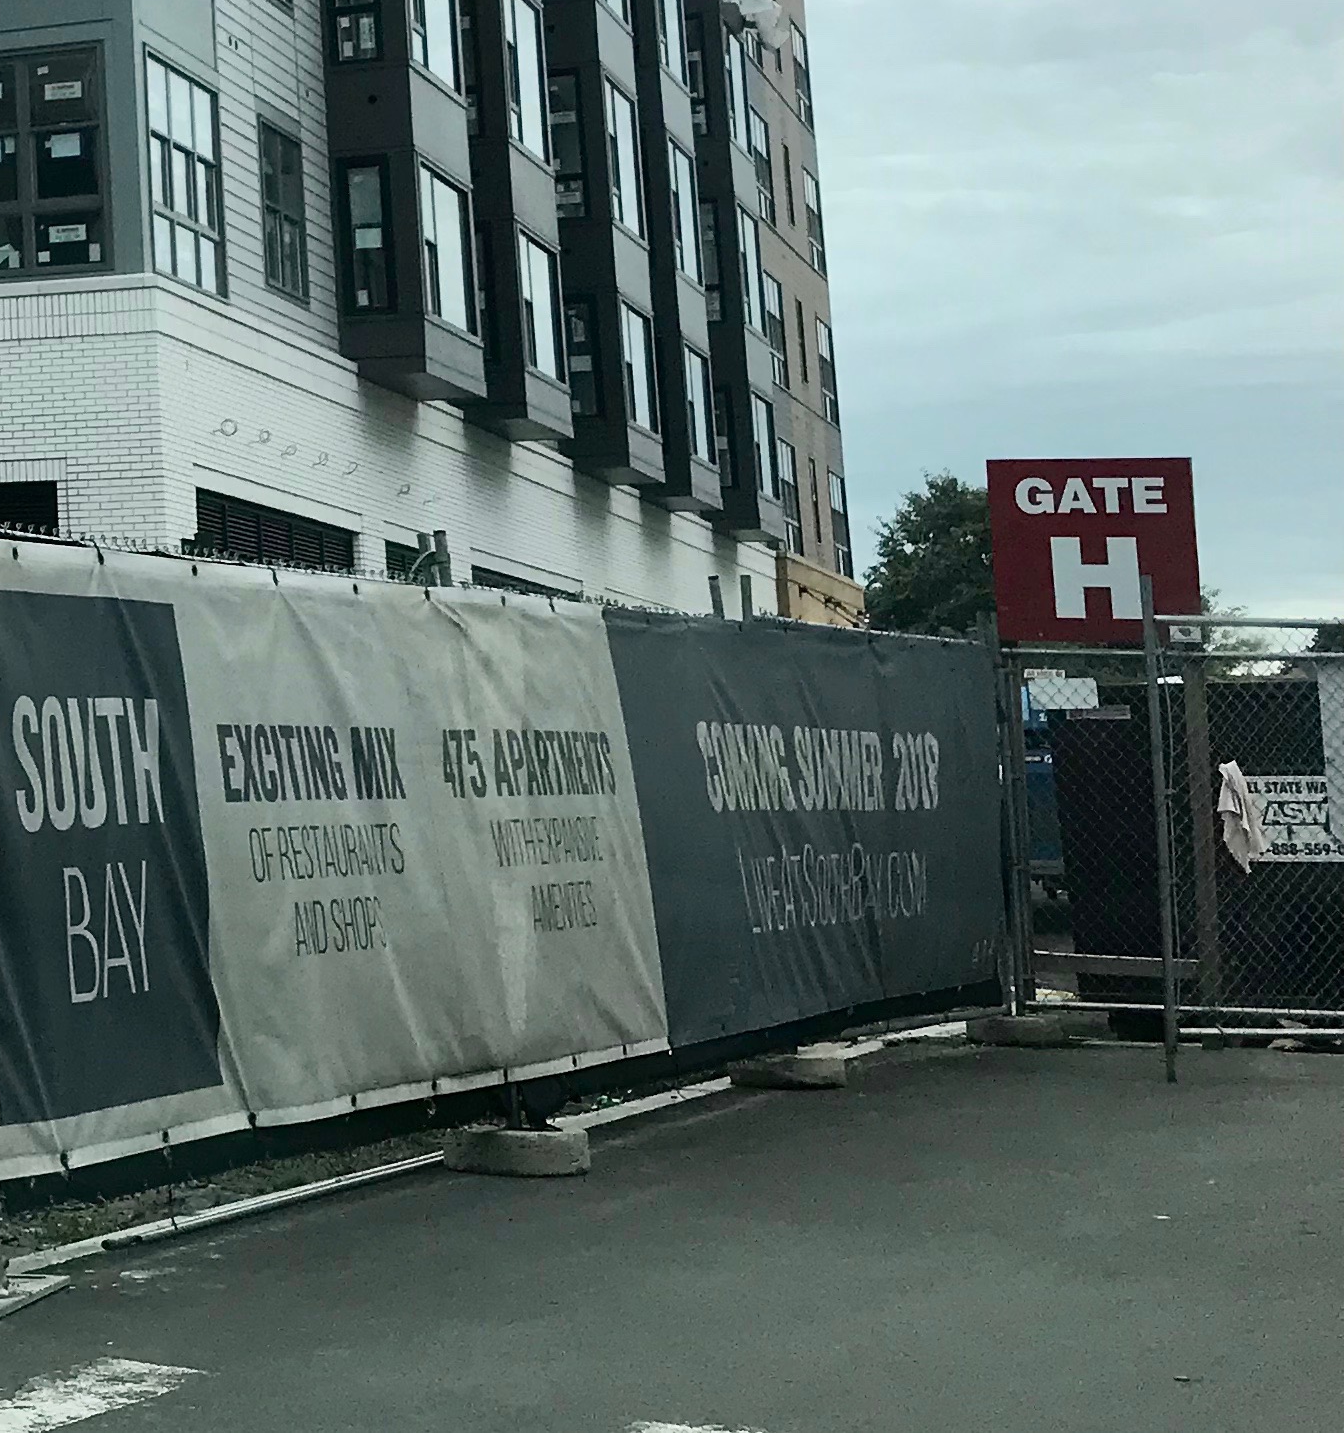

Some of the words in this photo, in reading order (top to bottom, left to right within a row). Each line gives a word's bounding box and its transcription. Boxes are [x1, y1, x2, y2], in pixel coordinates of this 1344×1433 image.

[1014, 477, 1168, 514] GATE
[1050, 536, 1143, 619] H
[12, 695, 164, 833] SOUTH
[217, 723, 348, 802] EXCITING
[350, 726, 407, 800] MIX
[442, 728, 487, 798] 475
[492, 728, 616, 796] APARTMENTS
[696, 721, 798, 813] COMING
[793, 725, 886, 811] SUMMER
[1264, 780, 1303, 794] STATE
[1264, 802, 1327, 824] ASW
[249, 827, 274, 883] OF
[277, 823, 405, 880] RESTAURANTS
[63, 860, 149, 1004] BAY
[294, 900, 328, 956] AND
[330, 896, 387, 953] SHOPS
